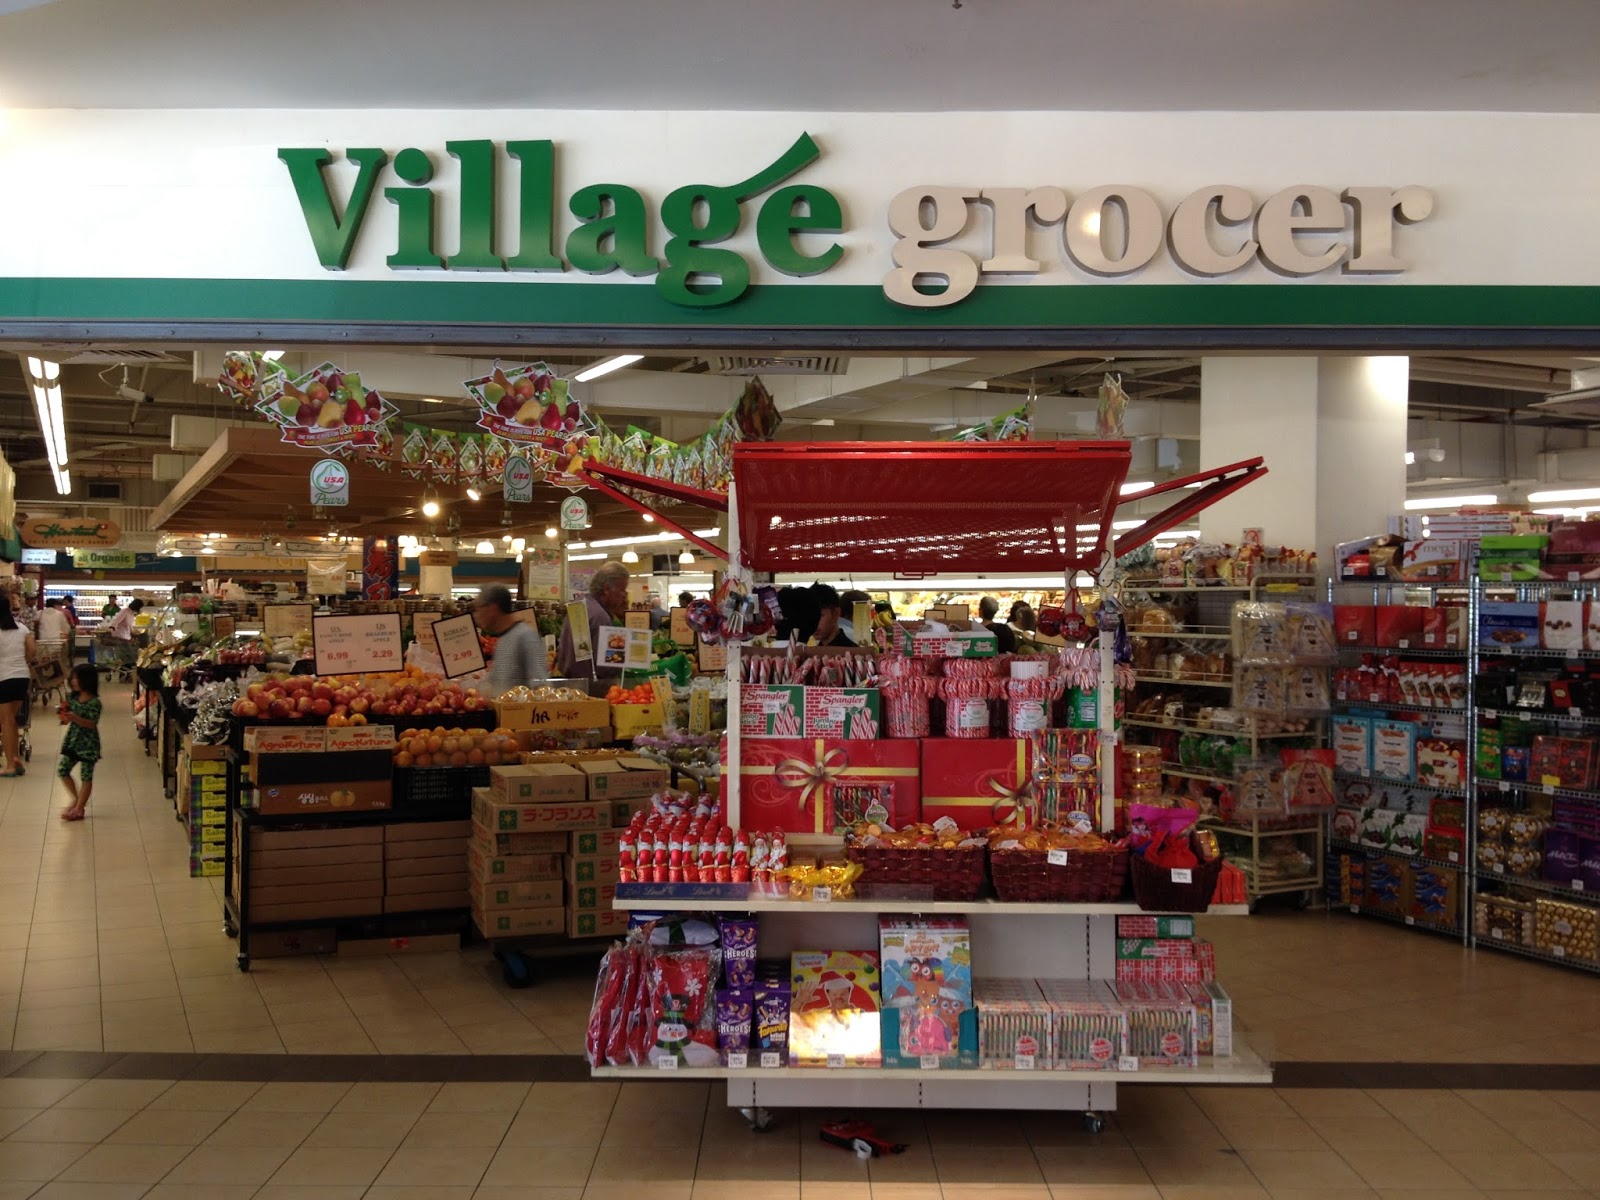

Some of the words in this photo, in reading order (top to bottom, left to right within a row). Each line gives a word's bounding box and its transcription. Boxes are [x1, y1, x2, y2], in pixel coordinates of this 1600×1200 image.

[277, 130, 846, 307] Village
[882, 184, 1434, 308] grocer
[324, 476, 344, 484] USA
[513, 472, 530, 480] USA
[314, 492, 347, 505] Pears
[507, 488, 531, 501] Pears
[90, 552, 130, 564] Organic
[327, 651, 349, 660] 6.99
[372, 649, 393, 658] 2.29
[453, 649, 473, 662] 2.99
[746, 691, 788, 701] Spangler
[822, 695, 865, 706] Spangler
[816, 722, 834, 730] Stick
[330, 739, 391, 750] AgroNature
[726, 949, 755, 959] HEROES
[720, 1024, 749, 1034] HEROES
